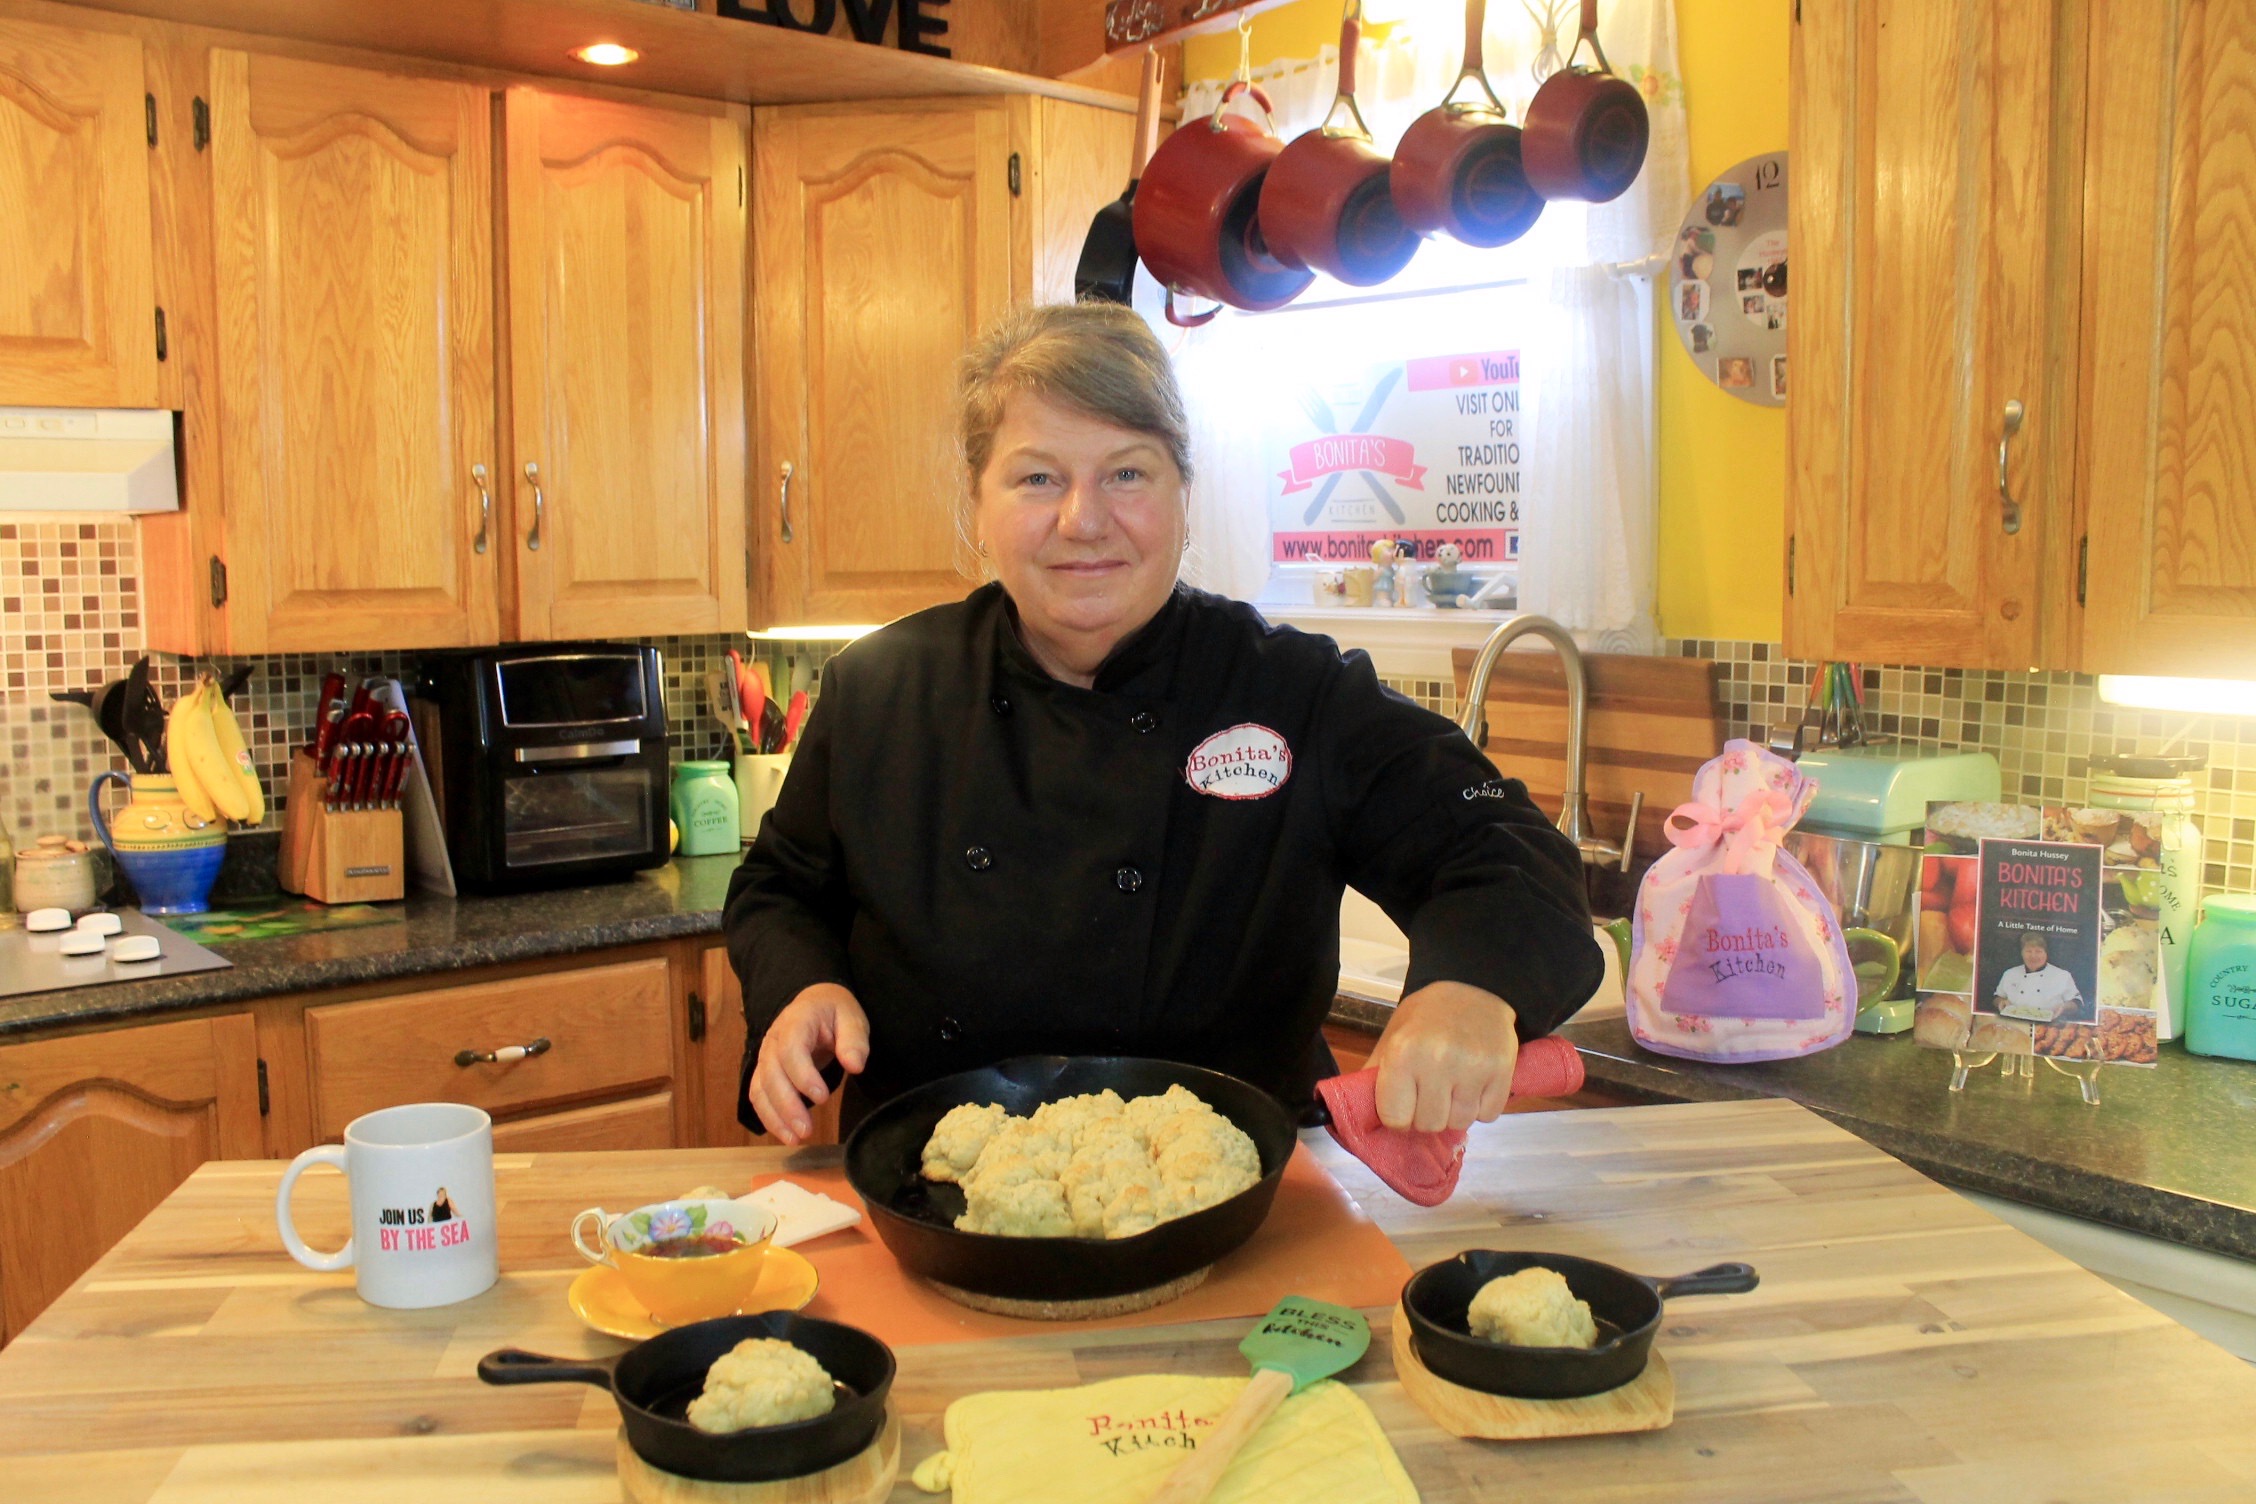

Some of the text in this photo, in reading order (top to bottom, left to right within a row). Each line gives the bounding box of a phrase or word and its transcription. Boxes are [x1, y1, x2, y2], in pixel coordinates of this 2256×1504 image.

[1755, 160, 1780, 190] 12
[1456, 392, 1488, 415] VISIT
[1490, 419, 1513, 438] FOR
[1313, 438, 1386, 470] BONITA'S
[1458, 443, 1520, 466] TRADITIO
[1328, 503, 1376, 517] KITCHEN
[1436, 500, 1519, 523] COOKING &
[1190, 744, 1286, 772] Bonita's
[1200, 762, 1279, 789] Kitchen
[693, 816, 728, 827] COFFEE
[2011, 848, 2069, 861] Bonita Hussey
[1998, 861, 2083, 888] BONITA'S
[2000, 888, 2079, 913] KITCHEN
[1706, 925, 1789, 953] Bonita's
[2005, 921, 2024, 930] Little
[2026, 923, 2045, 932] Taste
[2046, 924, 2055, 932] of
[2056, 926, 2078, 934] Home
[1708, 953, 1786, 984] Kitchen
[2209, 965, 2249, 988] COUNTRY
[379, 1208, 425, 1225] JOIN US
[380, 1220, 470, 1251] BY THE SEA
[1279, 1308, 1357, 1330] BLESS
[1297, 1319, 1330, 1330] THIS
